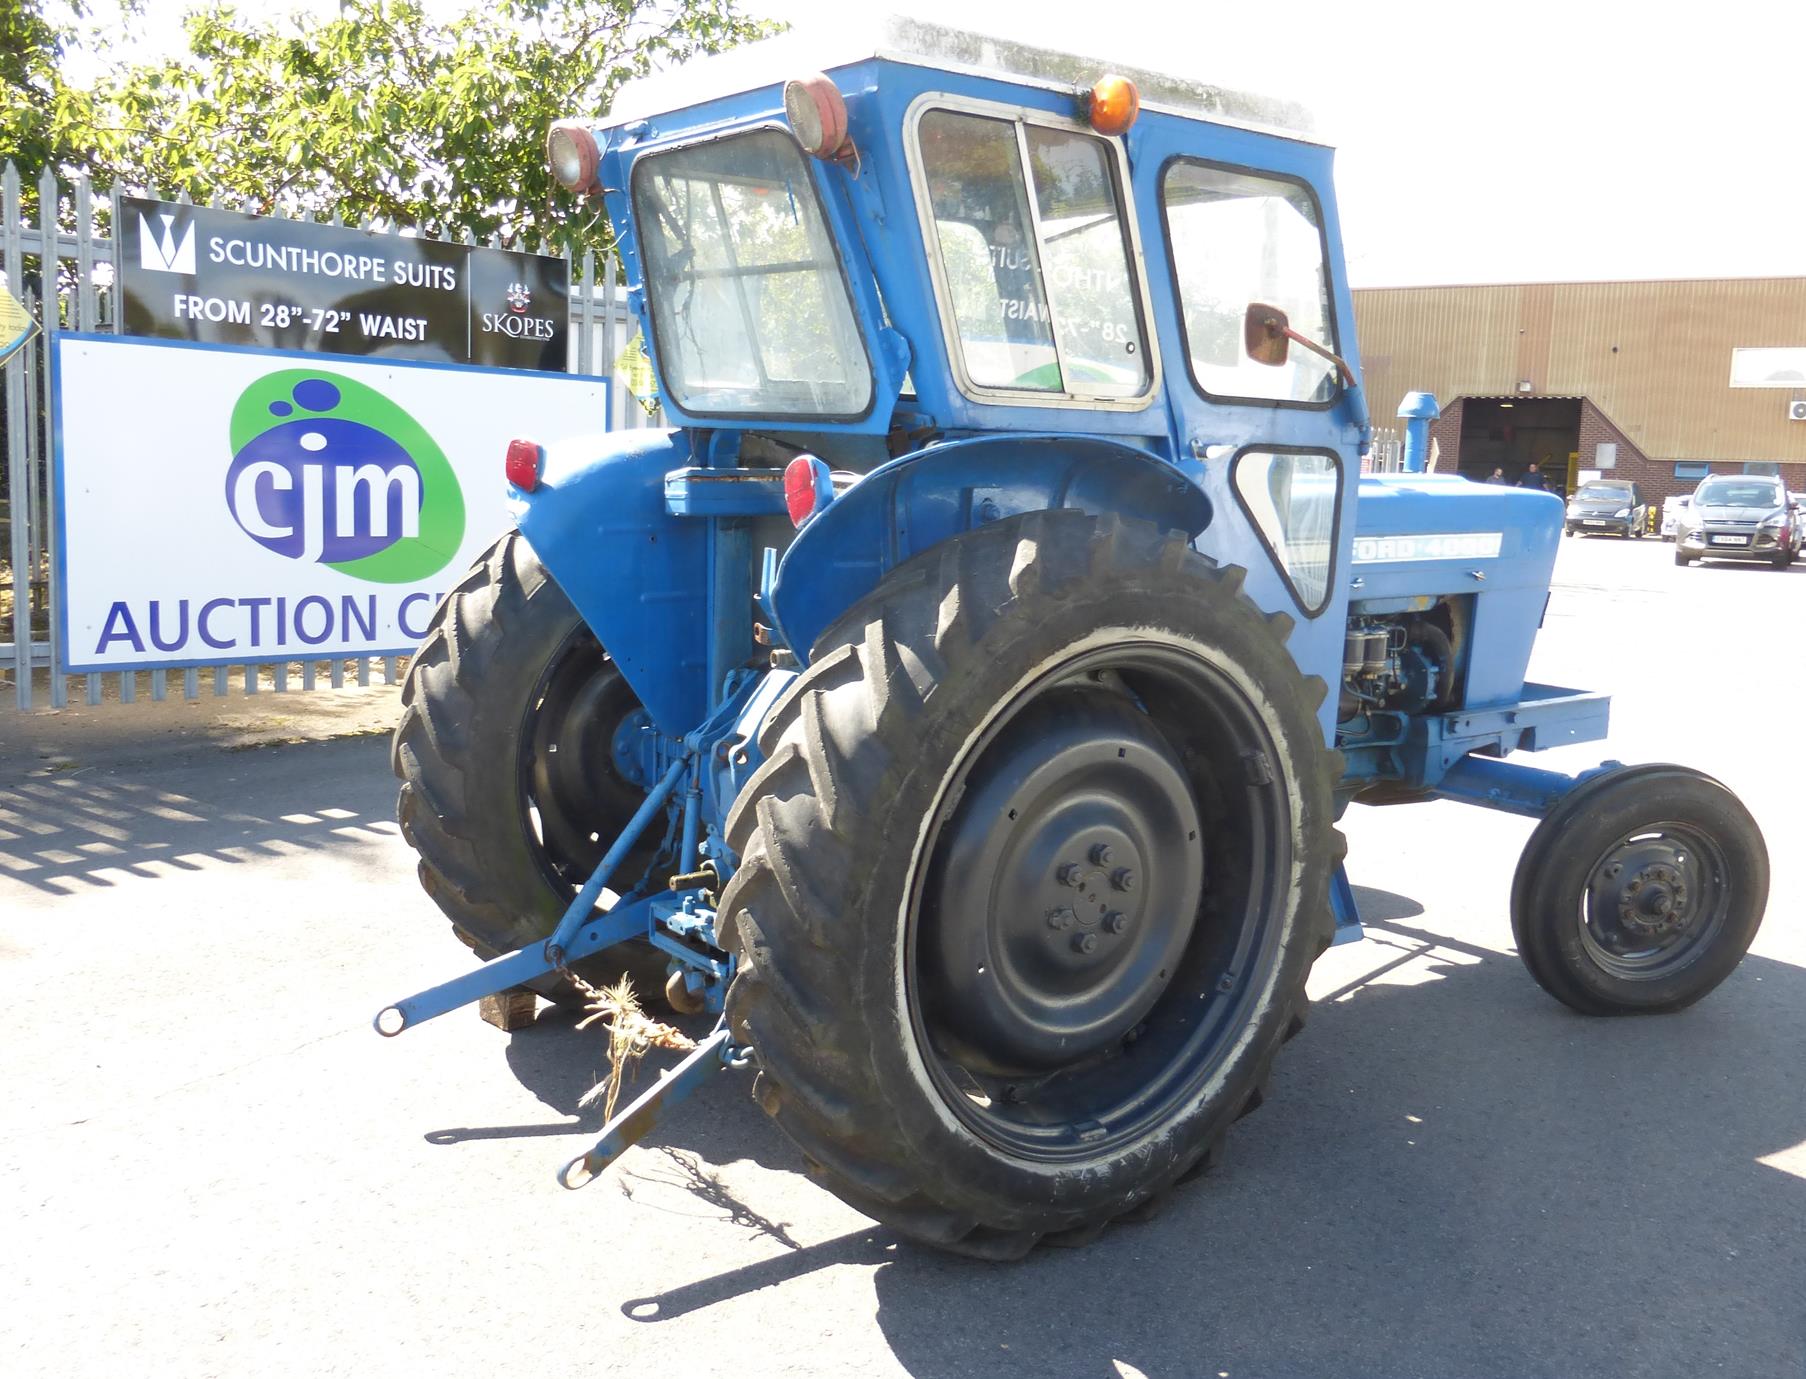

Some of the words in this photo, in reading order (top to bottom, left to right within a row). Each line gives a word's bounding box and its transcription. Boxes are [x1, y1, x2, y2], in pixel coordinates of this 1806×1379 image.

[208, 236, 386, 283] SCUNTHORPE
[392, 260, 457, 292] SUITS
[173, 294, 251, 325] FROM
[359, 313, 428, 342] WAIST
[482, 312, 555, 338] SKOPES
[234, 432, 420, 563] cjm
[94, 593, 378, 655] AUCTION
[397, 592, 446, 640] C
